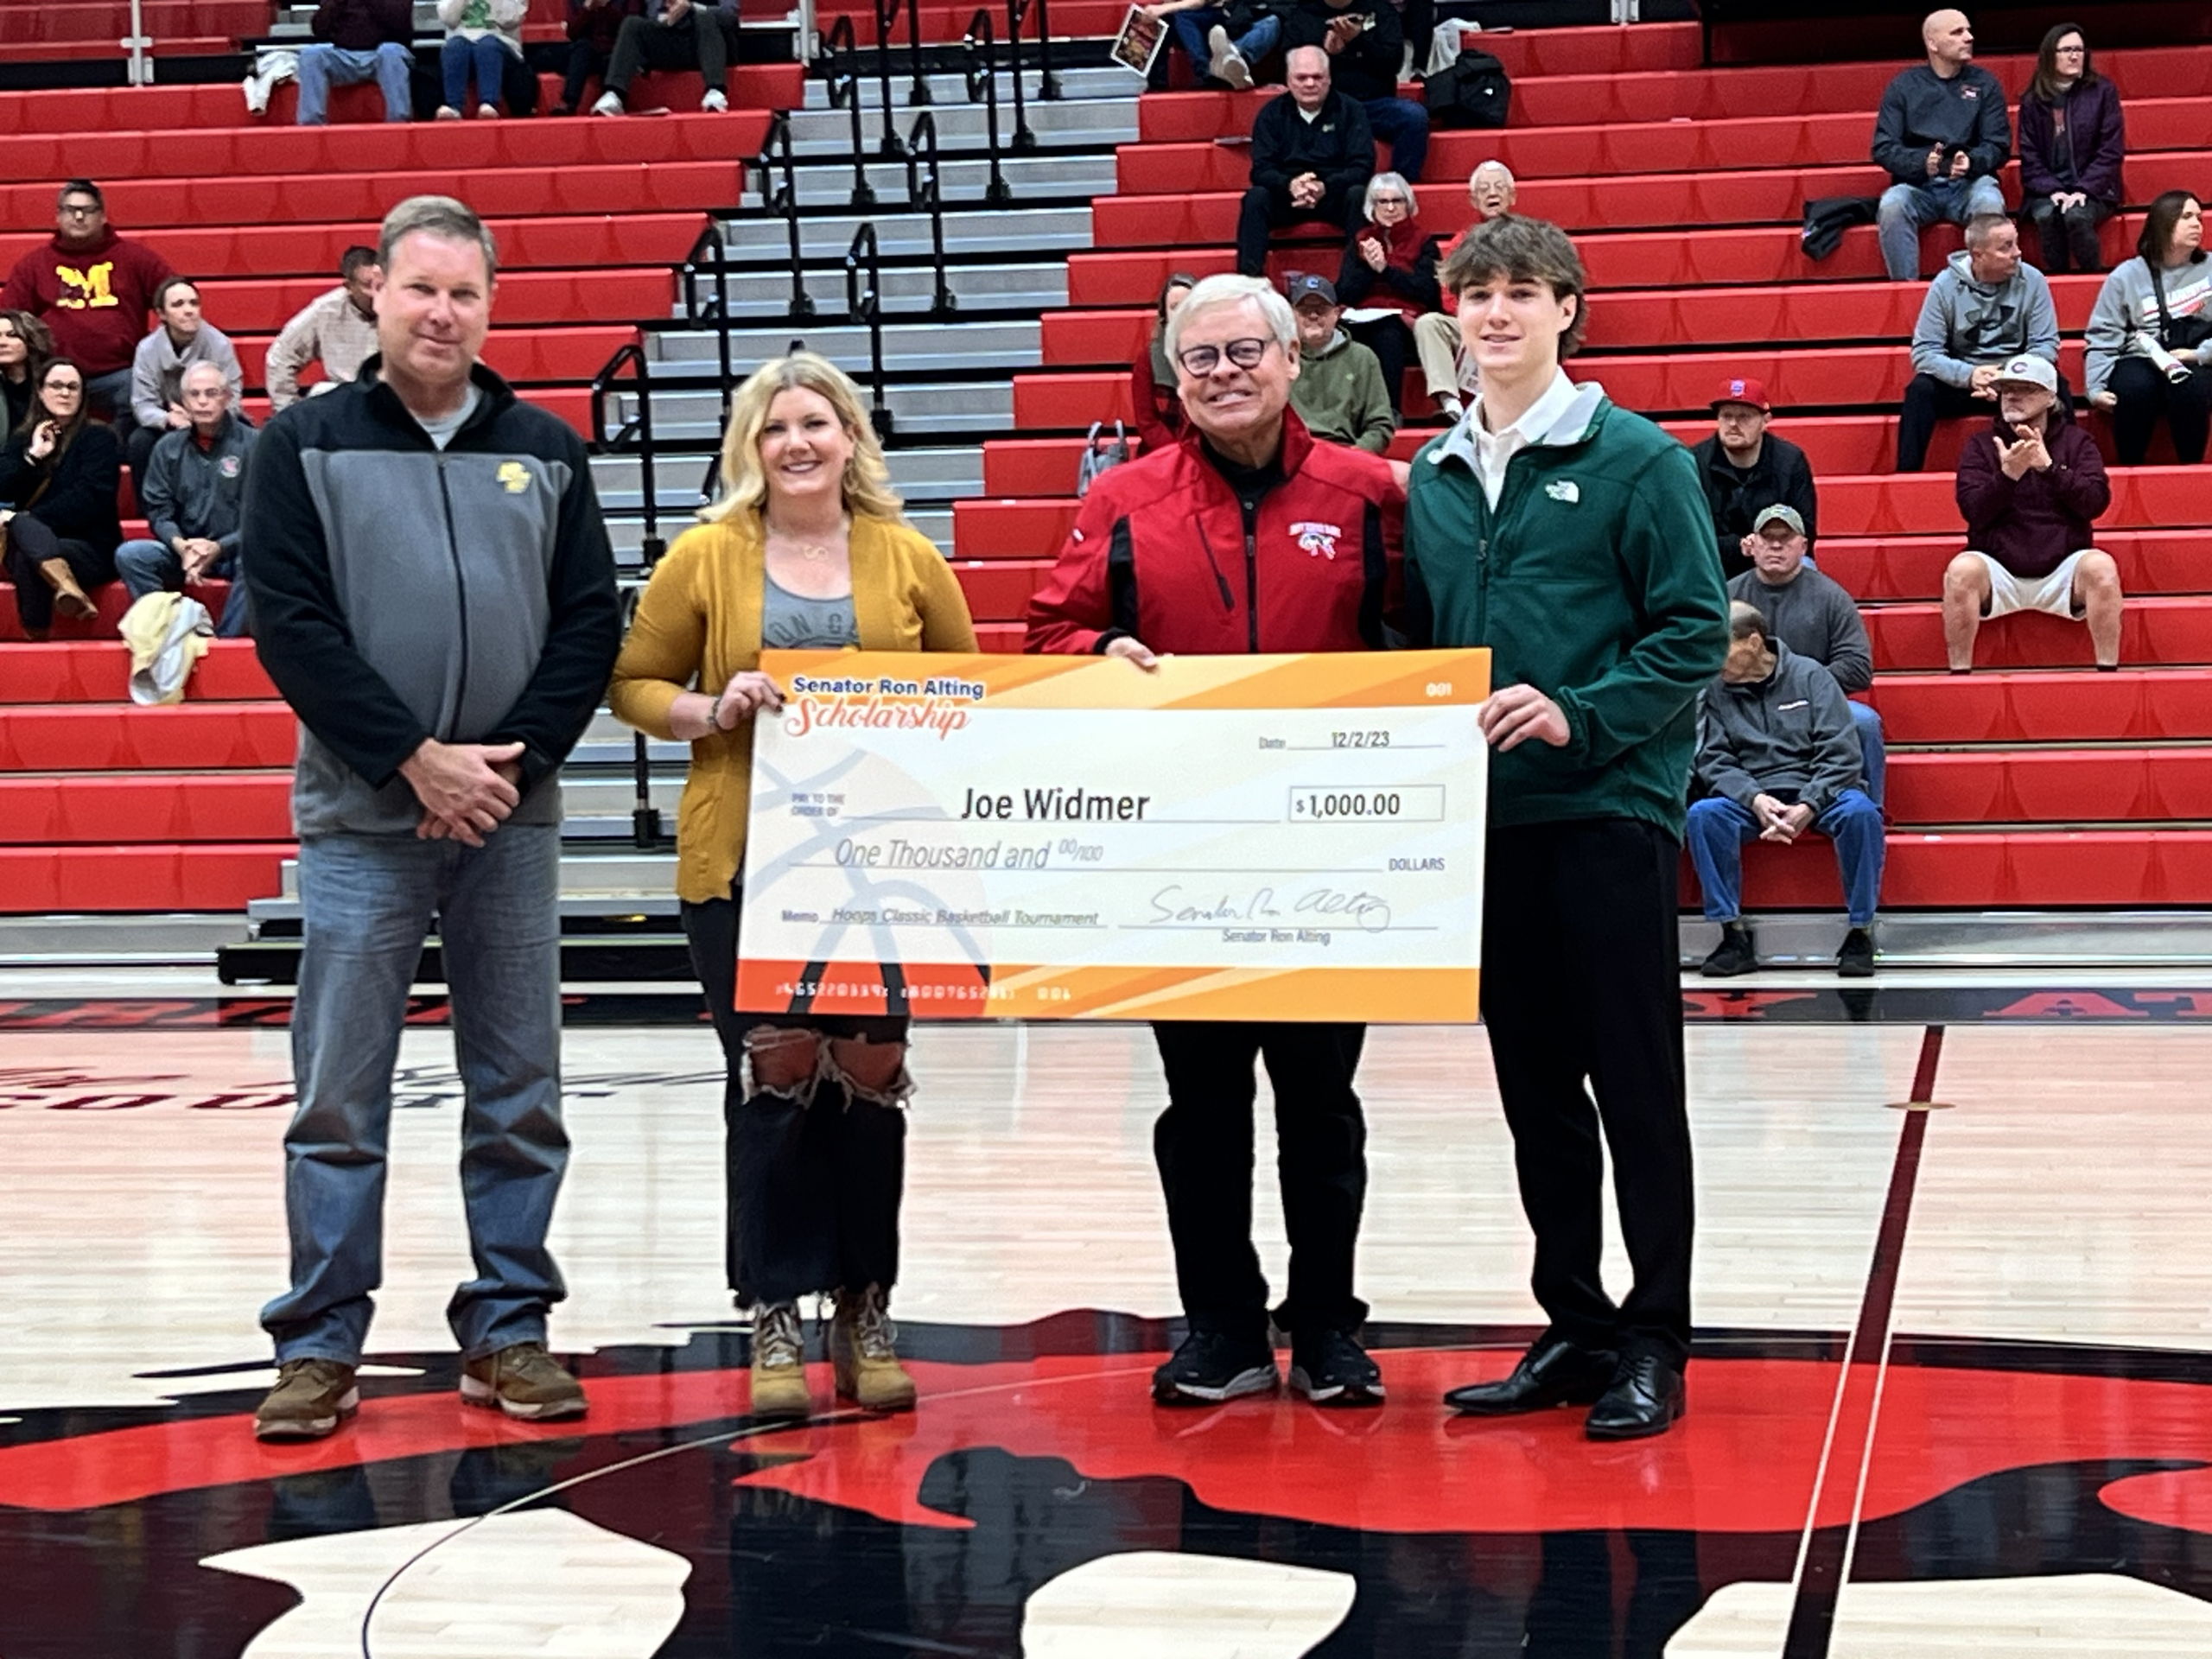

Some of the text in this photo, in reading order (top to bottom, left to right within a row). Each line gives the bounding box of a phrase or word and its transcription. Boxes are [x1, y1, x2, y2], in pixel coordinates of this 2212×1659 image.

[793, 677, 984, 701] Senator Ron Alting
[785, 697, 972, 741] Scholarship
[1259, 731, 1390, 750] Date 12/2/23
[961, 787, 1150, 821] Joe Widmer
[836, 837, 881, 867] One
[889, 839, 1002, 868] Thousand
[1004, 841, 1052, 869] and
[1389, 856, 1446, 872] DOLLARS
[782, 908, 1099, 925] Memo Hoops Classic Basketball Tournament
[1223, 928, 1332, 947] Senator Ron Alting
